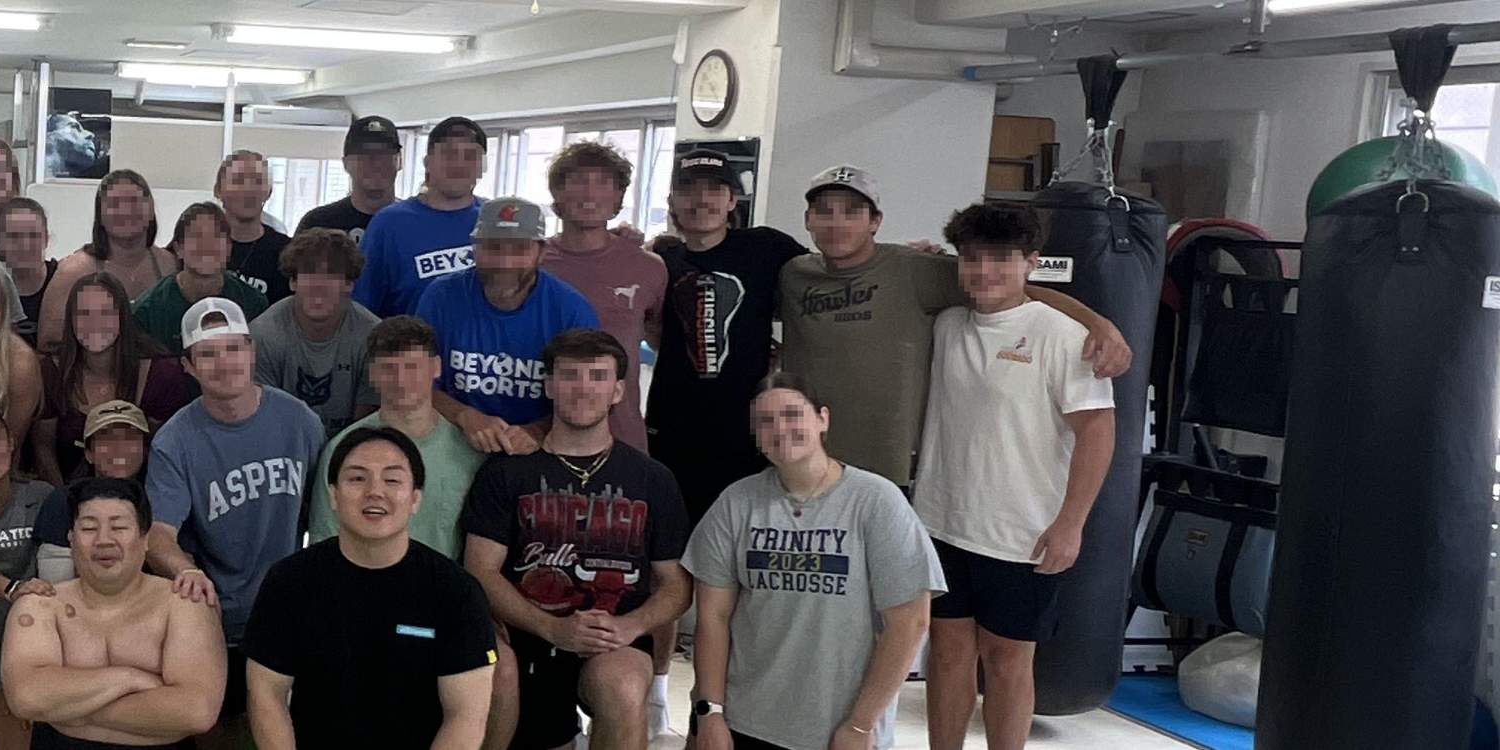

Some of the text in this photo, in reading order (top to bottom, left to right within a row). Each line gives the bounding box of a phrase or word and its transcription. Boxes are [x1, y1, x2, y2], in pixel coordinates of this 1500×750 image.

[1037, 260, 1067, 269] SAMI
[454, 373, 543, 399] SPORTS
[208, 458, 303, 522] ASPEN
[751, 527, 847, 553] TRINITY
[515, 542, 579, 571] Bulls
[768, 553, 820, 571] 2023
[747, 571, 847, 595] LACROSSE
